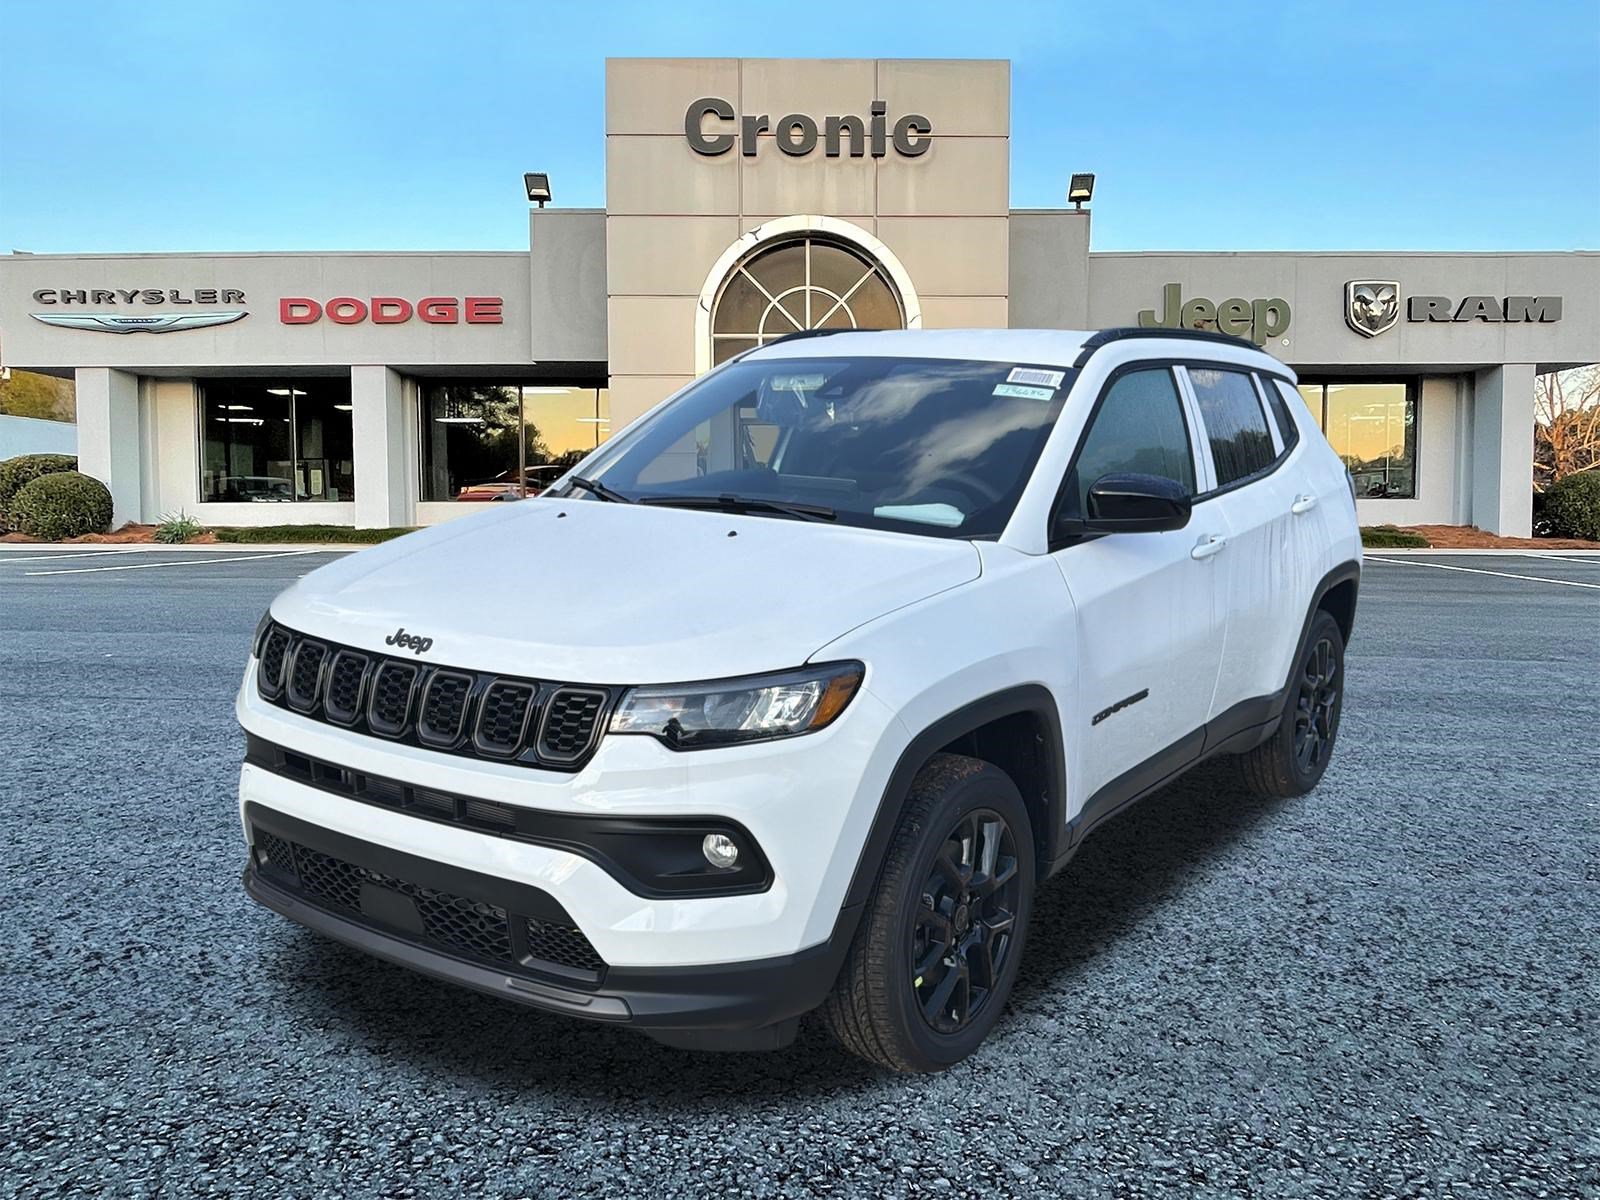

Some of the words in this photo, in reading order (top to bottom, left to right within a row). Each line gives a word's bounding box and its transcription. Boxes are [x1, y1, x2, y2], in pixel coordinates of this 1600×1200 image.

[684, 97, 932, 158] Cronic
[32, 288, 246, 305] CHRYSLER
[279, 296, 504, 324] DODGE
[1407, 295, 1563, 322] RAM
[1138, 282, 1292, 347] Jeep
[385, 627, 434, 656] Jeep
